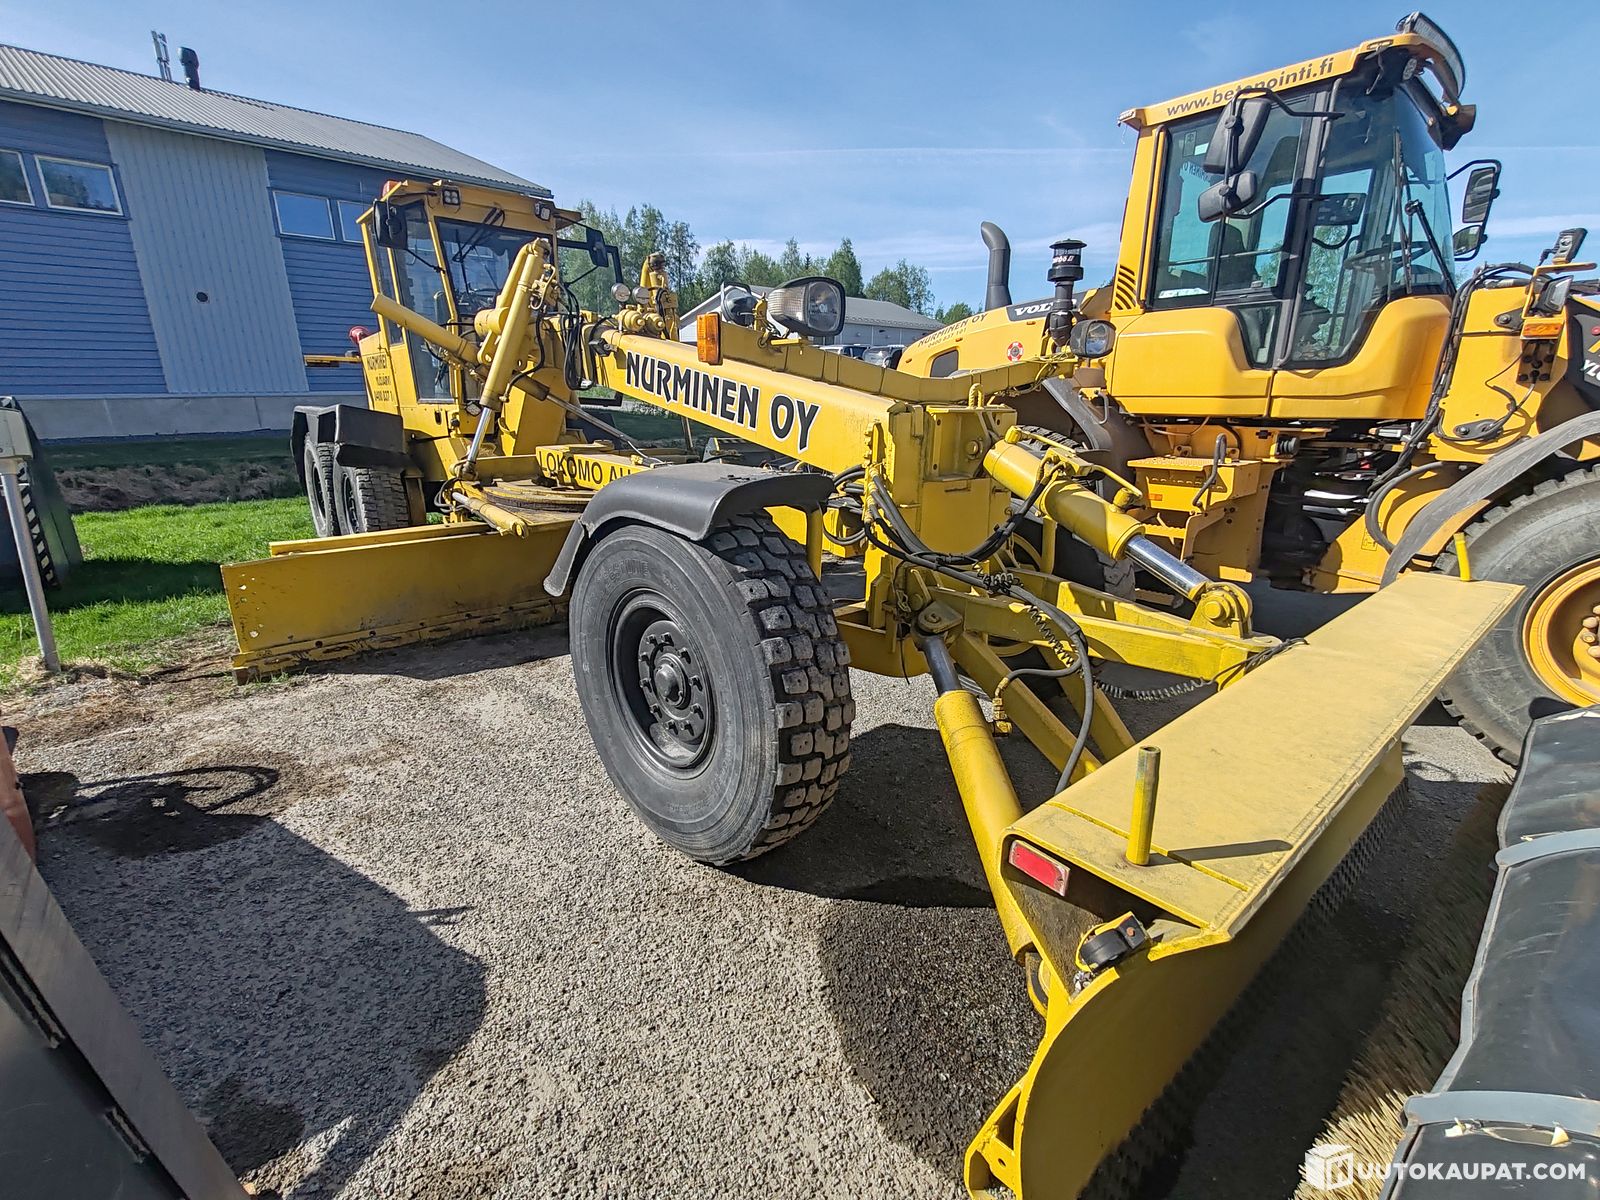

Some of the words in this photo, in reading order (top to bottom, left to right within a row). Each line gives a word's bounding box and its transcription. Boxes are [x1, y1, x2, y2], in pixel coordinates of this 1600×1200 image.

[971, 313, 988, 324] OY
[625, 351, 759, 429] NURMINEN
[770, 395, 820, 452] OY
[539, 450, 603, 485] LOKOMO
